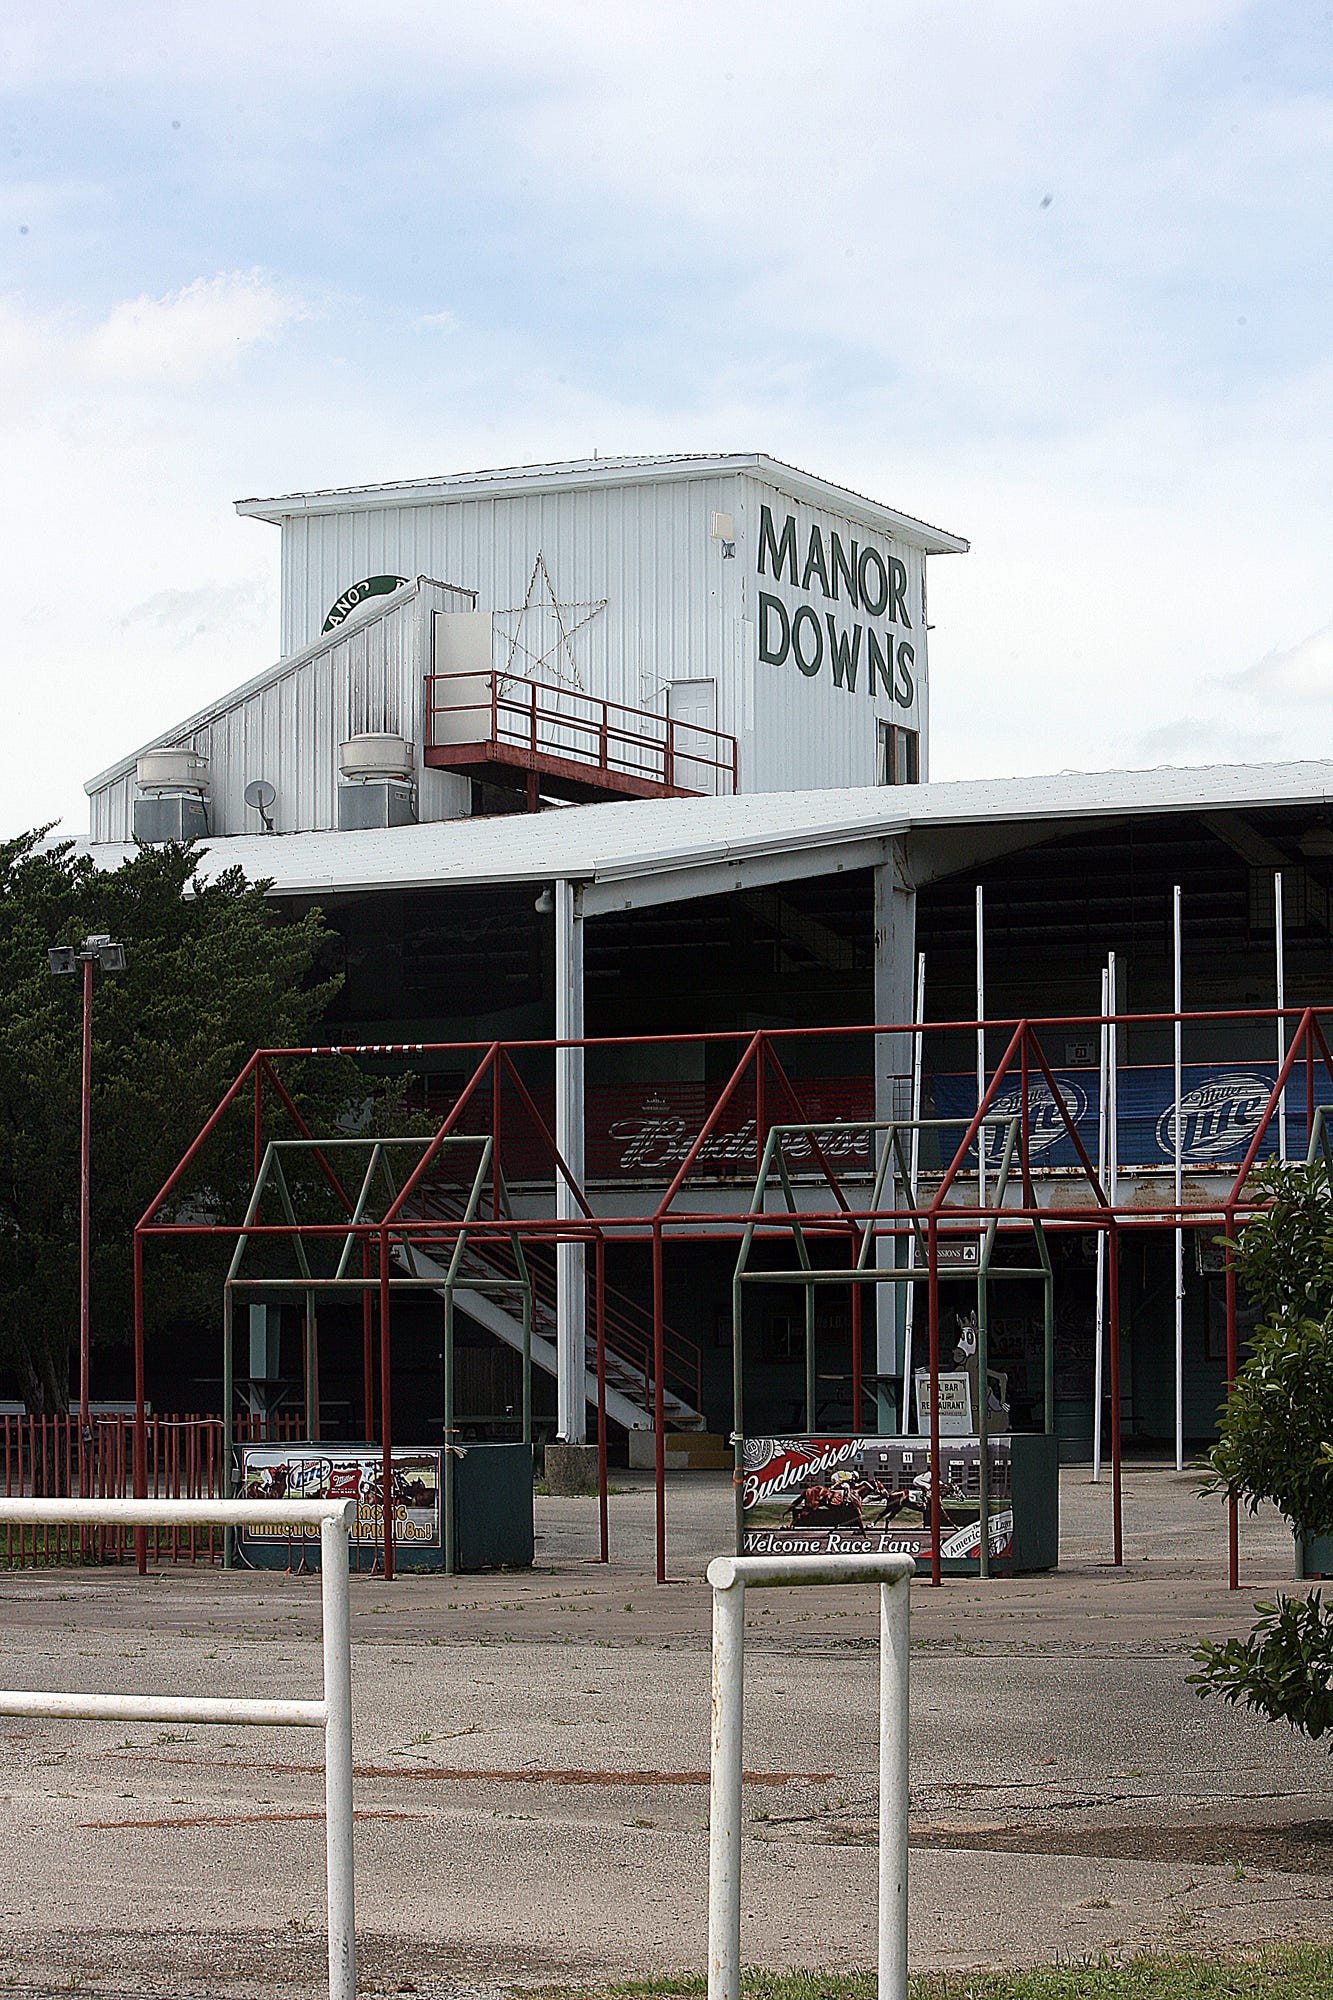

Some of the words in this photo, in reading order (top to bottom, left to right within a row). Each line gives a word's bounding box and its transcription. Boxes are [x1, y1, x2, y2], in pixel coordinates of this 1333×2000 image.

[757, 504, 913, 630] MANOR
[758, 590, 915, 709] DOWNS
[999, 1089, 1050, 1112] Mller
[926, 1383, 943, 1391] FL
[944, 1383, 959, 1391] BAR
[921, 1401, 965, 1410] REAURANT
[742, 1438, 867, 1509] Budweiser
[356, 1504, 408, 1521] ACNG
[351, 1521, 386, 1538] APRI
[743, 1533, 820, 1553] Welcome
[827, 1533, 872, 1553] Race
[876, 1533, 921, 1553] Fans
[949, 1525, 993, 1556] Americn
